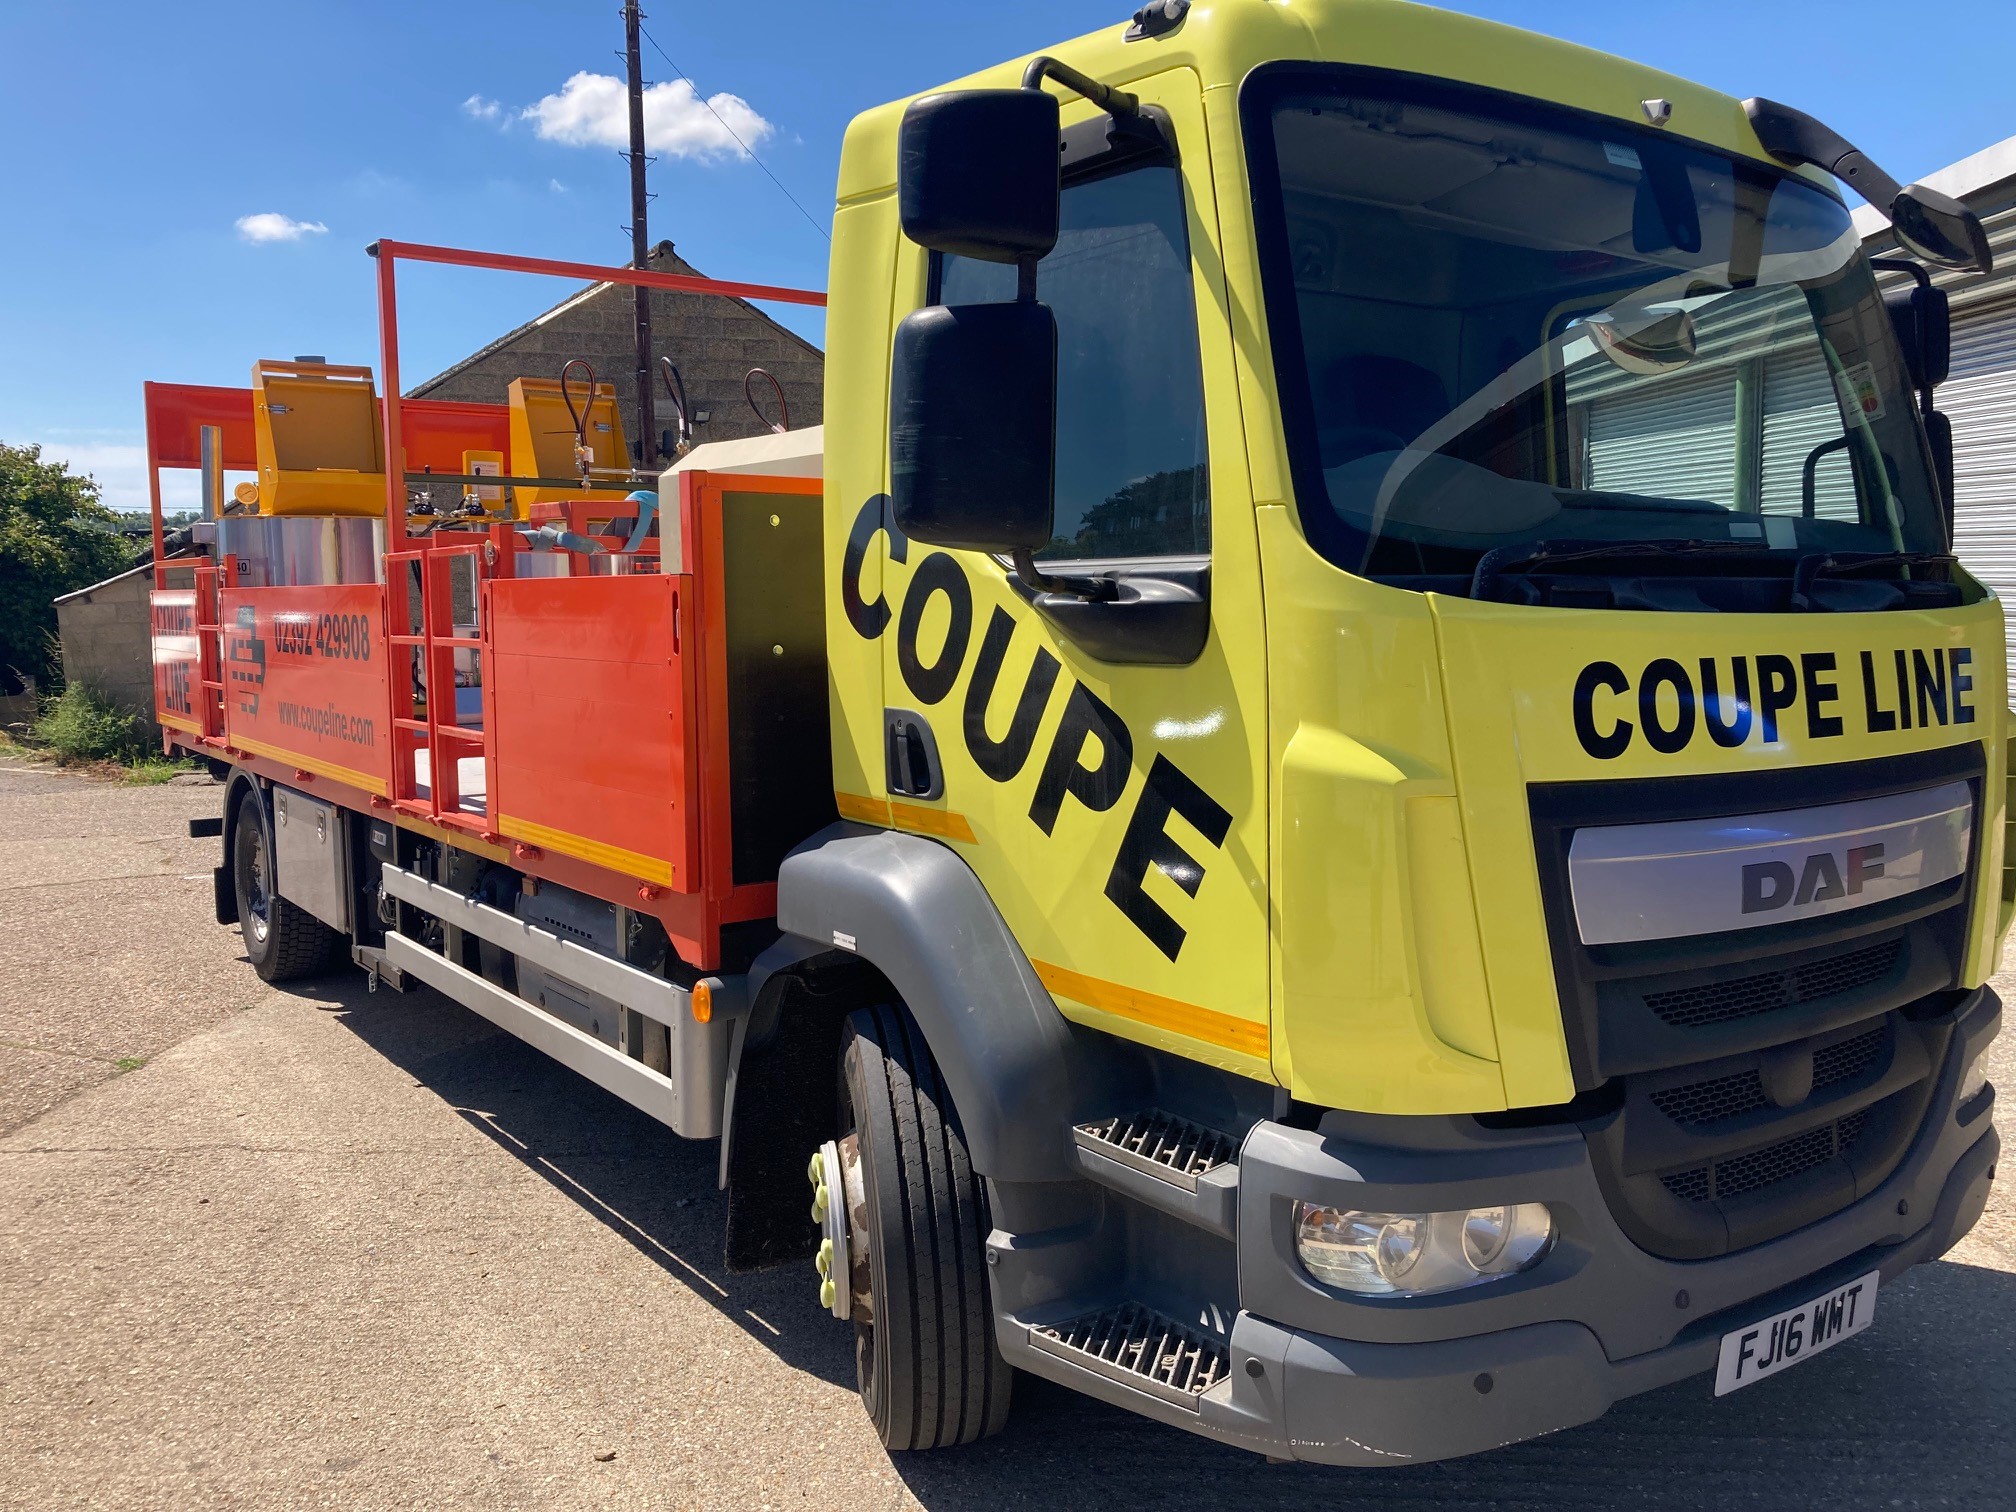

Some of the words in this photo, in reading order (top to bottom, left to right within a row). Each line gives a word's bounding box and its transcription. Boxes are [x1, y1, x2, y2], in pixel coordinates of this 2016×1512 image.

[274, 613, 312, 655] 02392
[316, 614, 370, 661] 429908
[164, 661, 191, 714] LINE
[1573, 653, 1843, 759] COUPE
[1860, 648, 1975, 733] LINE
[278, 701, 374, 746] www.coupeline.com
[843, 494, 1233, 963] COUPE
[1742, 843, 1884, 914] DAF
[1736, 1313, 1805, 1379] FJ16
[1810, 1284, 1862, 1347] WMT
